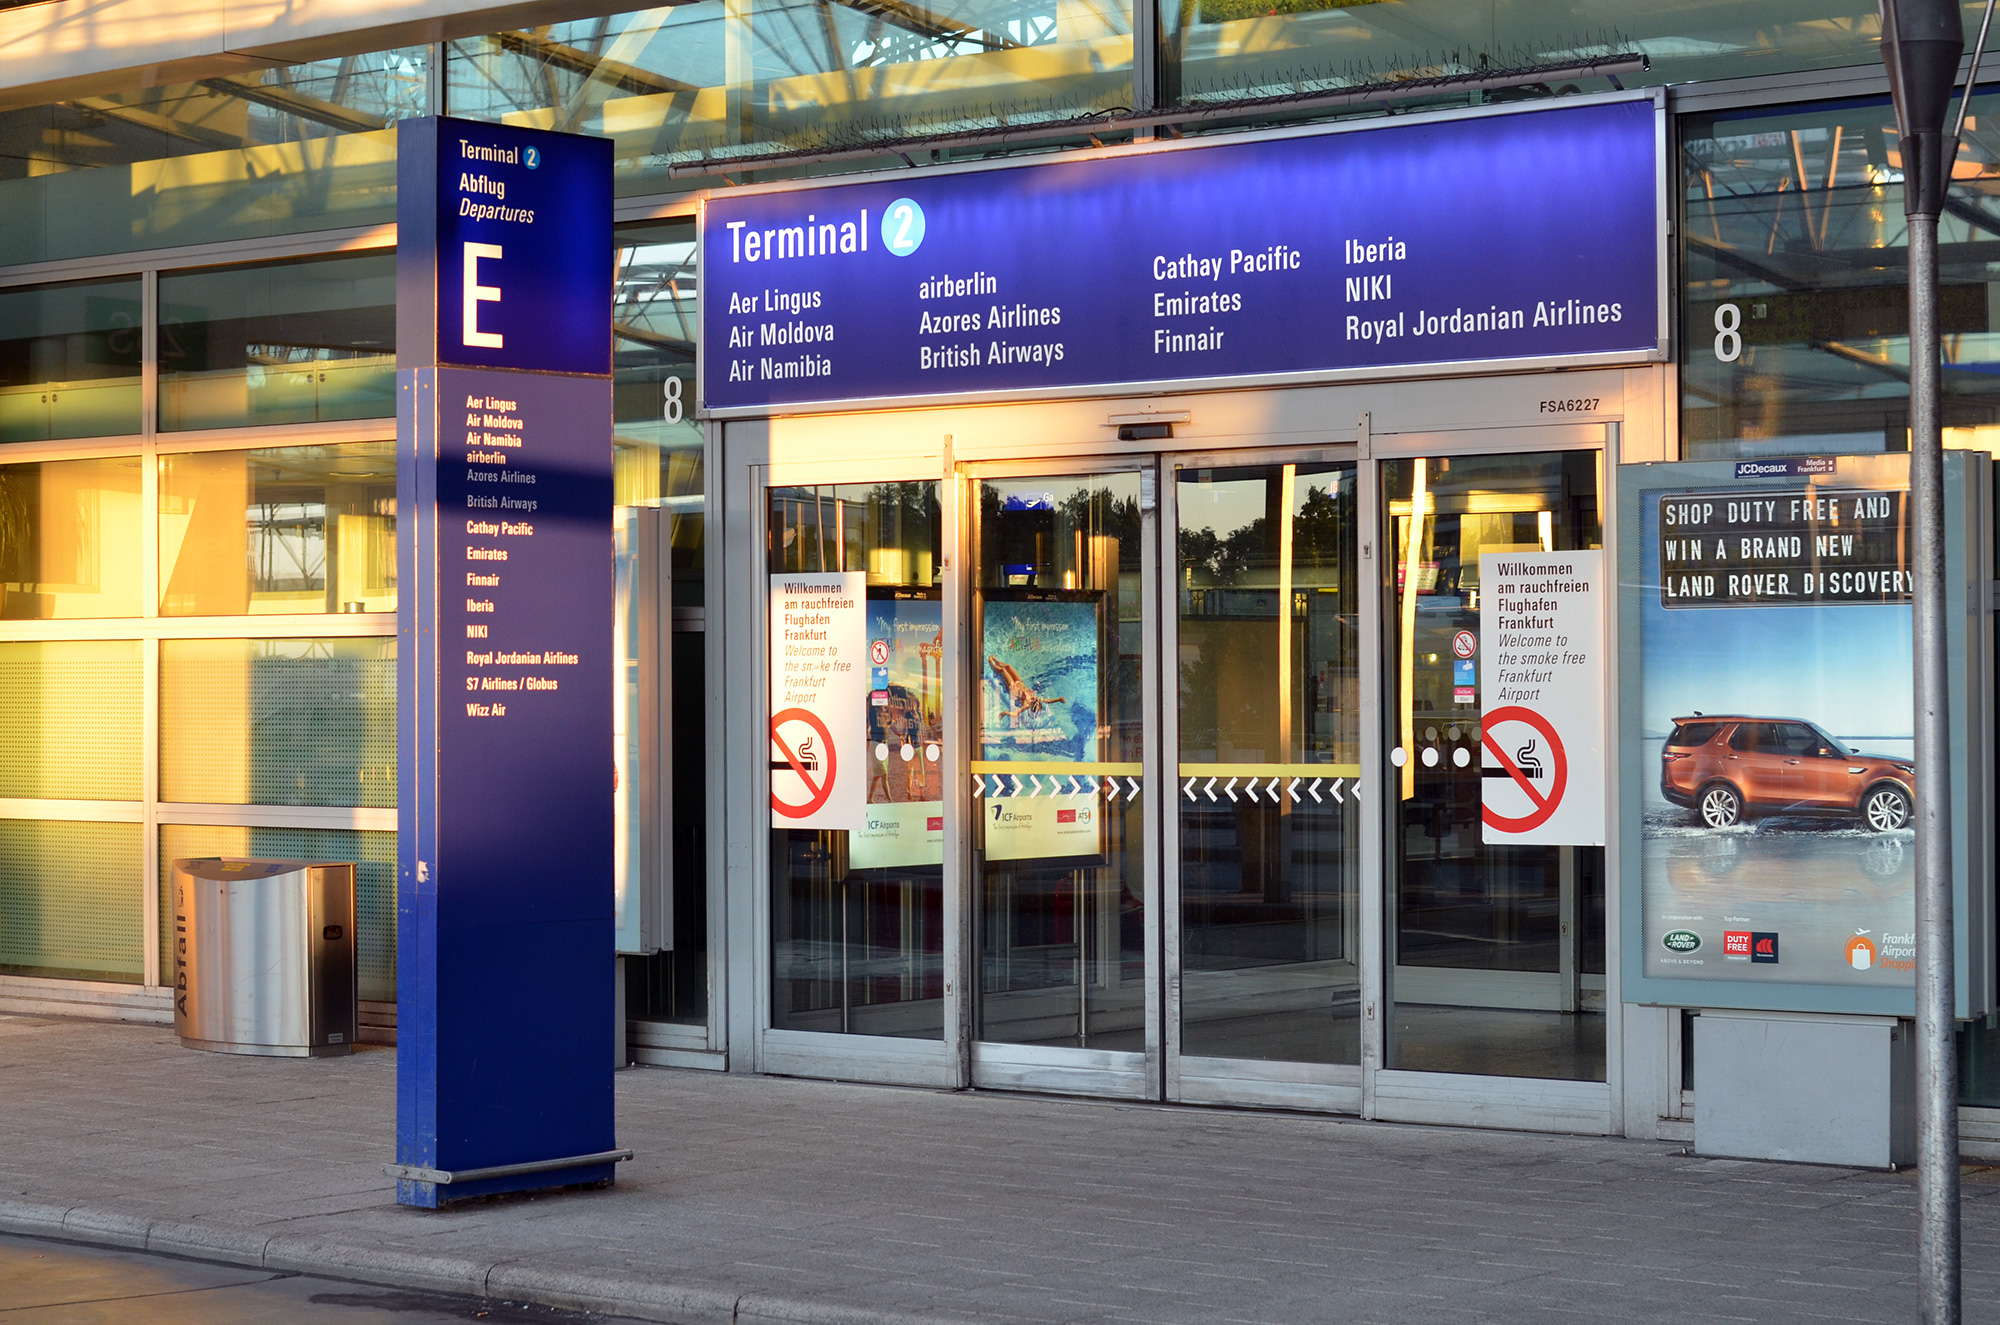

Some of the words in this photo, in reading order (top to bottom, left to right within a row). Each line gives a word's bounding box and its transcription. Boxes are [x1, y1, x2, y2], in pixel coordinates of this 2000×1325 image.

[460, 140, 517, 164] Terminal
[527, 148, 536, 166] 2
[459, 173, 504, 199] Abflug
[460, 198, 534, 223] Departures
[727, 209, 867, 262] Terminal
[892, 204, 914, 249] 2
[1346, 236, 1405, 264] Iberia
[1154, 254, 1222, 281] Cathay
[1231, 246, 1300, 273] Pacific
[920, 272, 996, 299] airberlin
[1346, 275, 1391, 302] NIKI
[463, 242, 503, 348] E
[729, 292, 758, 314] Aer
[765, 289, 821, 314] Lingus
[1155, 291, 1241, 316] Emirates
[920, 311, 980, 334] Azores
[988, 304, 1060, 329] Airlines
[1347, 312, 1403, 344] Royal
[1413, 306, 1523, 335] Jordanian
[1533, 300, 1621, 327] Airlines
[729, 326, 754, 348] Air
[761, 321, 833, 345] Moldova
[1155, 326, 1224, 353] Finnair
[1715, 304, 1741, 362] 8
[921, 343, 980, 369] British
[988, 341, 1063, 366] Airways
[729, 360, 754, 382] Air
[761, 354, 830, 379] Namibia
[467, 395, 483, 408] Aer
[486, 397, 516, 413] Lingus
[663, 376, 682, 424] 8
[1541, 399, 1599, 413] FSA6227
[467, 414, 481, 426] Air
[484, 415, 523, 429] Moldova
[467, 432, 481, 445] Air
[484, 433, 521, 447] Namibia
[467, 451, 505, 464] airberlin
[467, 469, 498, 482] Azores
[501, 470, 535, 483] Airlines
[1738, 464, 1787, 474] JCDecaux
[468, 495, 497, 508] British
[501, 496, 537, 512] Airways
[1666, 504, 1712, 525] SHOP
[1728, 501, 1775, 523] DUTY
[1791, 499, 1838, 520] FREE
[1854, 497, 1891, 519] AND
[467, 521, 499, 537] Cathay
[502, 522, 533, 535] Pacific
[467, 547, 507, 560] Emirates
[1666, 540, 1701, 560] WIN
[1716, 539, 1726, 559] A
[1741, 537, 1800, 558] BRAND
[1816, 535, 1852, 557] NEW
[1498, 562, 1573, 576] Willkommen
[467, 573, 499, 586] Finnair
[1498, 582, 1516, 594] am
[1520, 579, 1589, 594] rauchfreien
[1667, 575, 1715, 597] LAND
[1728, 571, 1790, 595] ROVER
[1804, 570, 1914, 593] DISCOVERY
[784, 583, 842, 594] Willkommen
[467, 599, 494, 612] Iberia
[784, 600, 797, 609] am
[801, 598, 854, 609] rauchfreien
[1498, 598, 1557, 612] Flughafen
[784, 613, 830, 627] Flughafen
[1498, 616, 1554, 630] Frankfurt
[467, 625, 487, 638] NIKI
[784, 629, 827, 641] Frankfurt
[1498, 634, 1552, 646] Welcome
[1556, 635, 1567, 646] to
[784, 645, 824, 657] Welcome
[829, 646, 837, 657] to
[1498, 652, 1516, 664] the
[1520, 653, 1558, 664] smoke
[1562, 651, 1585, 664] free
[467, 651, 492, 667] Royal
[495, 652, 541, 664] Jordanian
[543, 652, 578, 664] Airlines
[784, 660, 799, 672] the
[833, 660, 851, 672] free
[467, 677, 479, 690] S7
[481, 677, 517, 690] Airlines
[520, 677, 524, 690] /
[527, 677, 557, 690] Globus
[784, 675, 825, 688] Frankfurt
[1498, 669, 1552, 683] Frankfurt
[784, 691, 816, 704] Airport
[1498, 687, 1540, 702] Airport
[467, 704, 489, 716] Wizz
[492, 703, 506, 716] Air
[868, 820, 879, 829] ICF
[880, 821, 899, 829] Airports
[1002, 813, 1013, 822] ICF
[1882, 933, 1915, 944] Frankf
[177, 914, 188, 1018] Abfall
[1880, 958, 1916, 972] Shoppi
